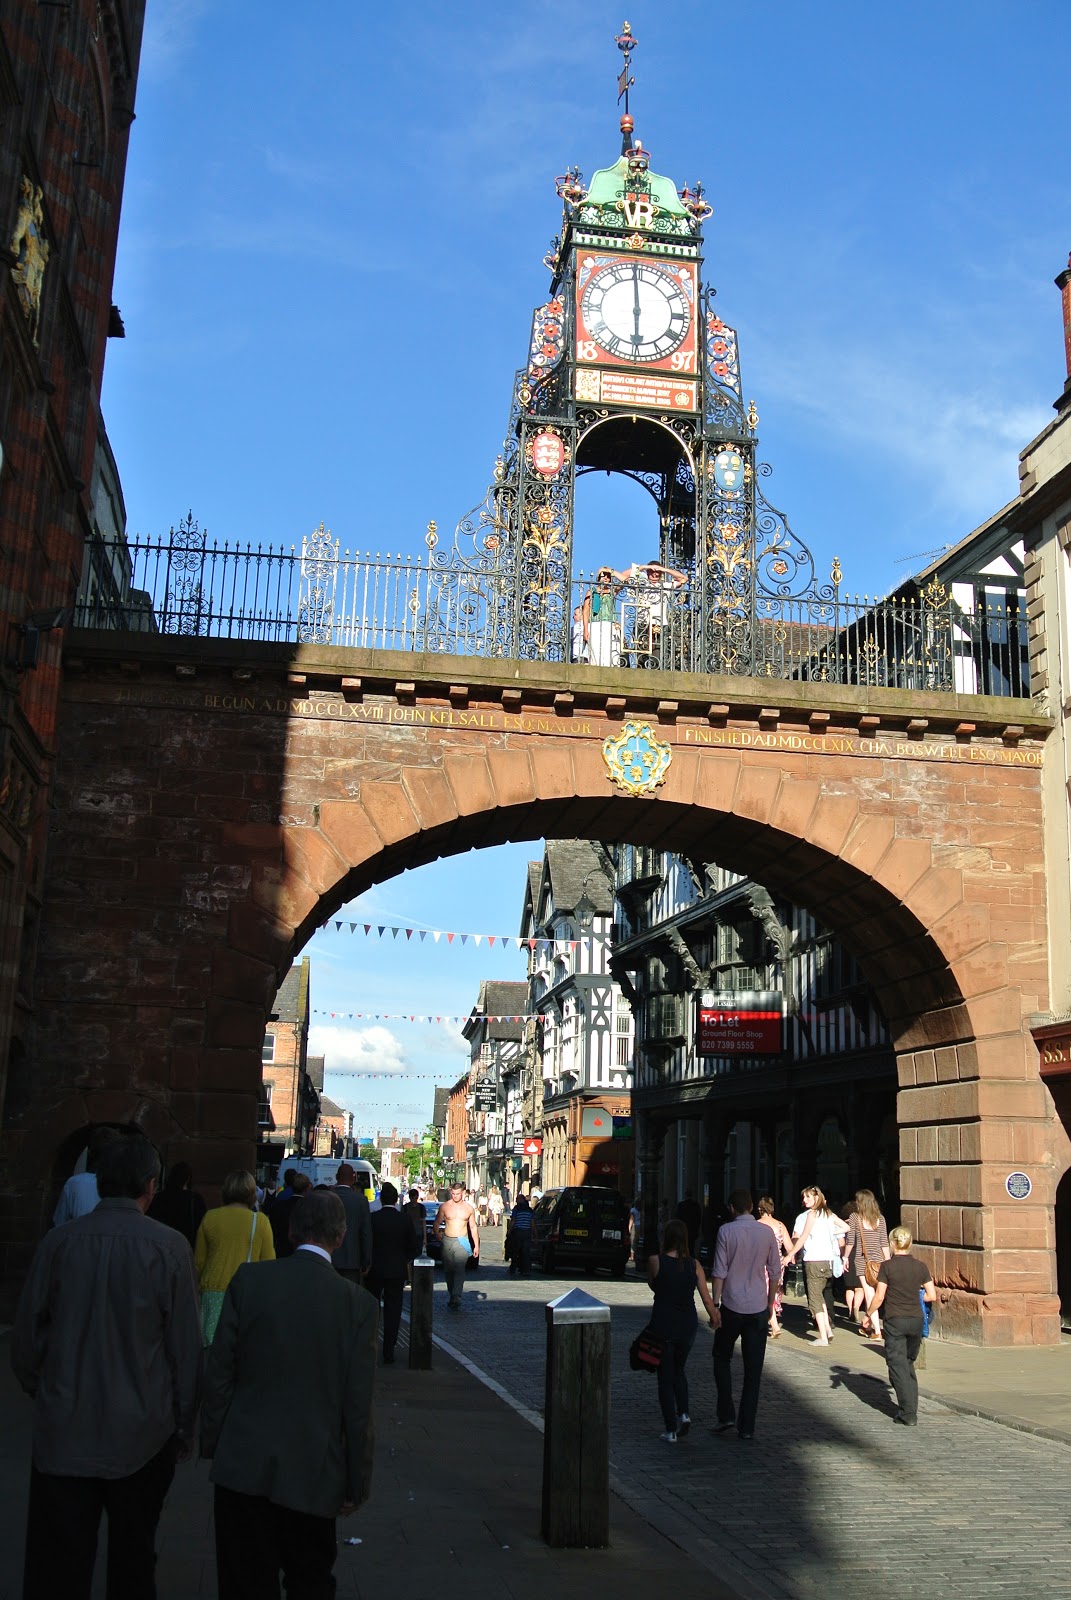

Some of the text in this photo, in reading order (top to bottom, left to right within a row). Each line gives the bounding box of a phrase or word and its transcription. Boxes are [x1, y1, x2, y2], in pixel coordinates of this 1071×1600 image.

[577, 340, 598, 361] 18
[671, 350, 694, 371] 97
[203, 694, 256, 710] BEGUN
[387, 707, 425, 723] JOHN
[430, 710, 499, 728] KELSALL
[685, 729, 752, 745] FINISHED
[896, 743, 968, 760] BOSWELL
[701, 1014, 739, 1027] To Let
[701, 1040, 755, 1049] 020 7399 5555
[727, 1030, 745, 1038] Floor
[746, 1031, 763, 1039] Shop
